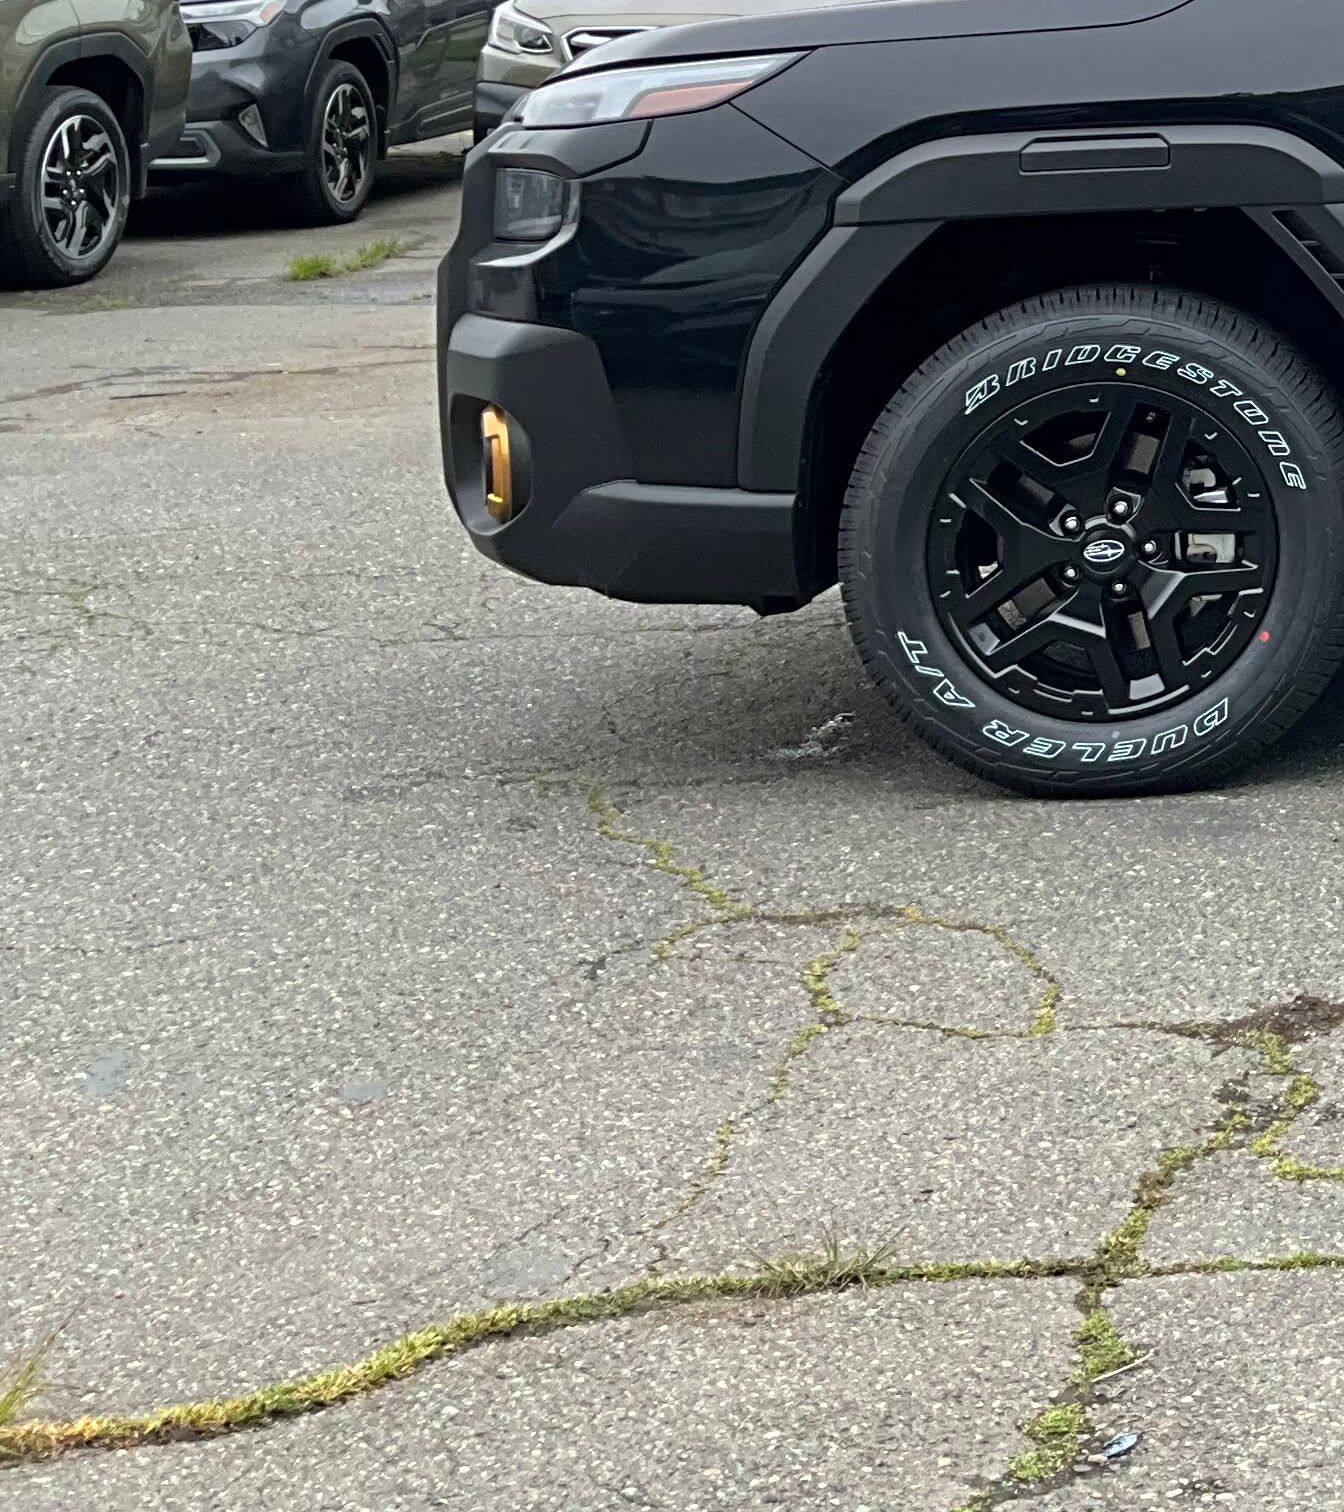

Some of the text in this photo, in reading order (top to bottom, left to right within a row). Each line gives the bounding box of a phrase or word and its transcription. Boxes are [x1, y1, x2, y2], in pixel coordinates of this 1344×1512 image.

[964, 344, 1307, 491] BRIDGESTONE
[897, 630, 976, 710] A/T
[982, 696, 1231, 764] DUELER
